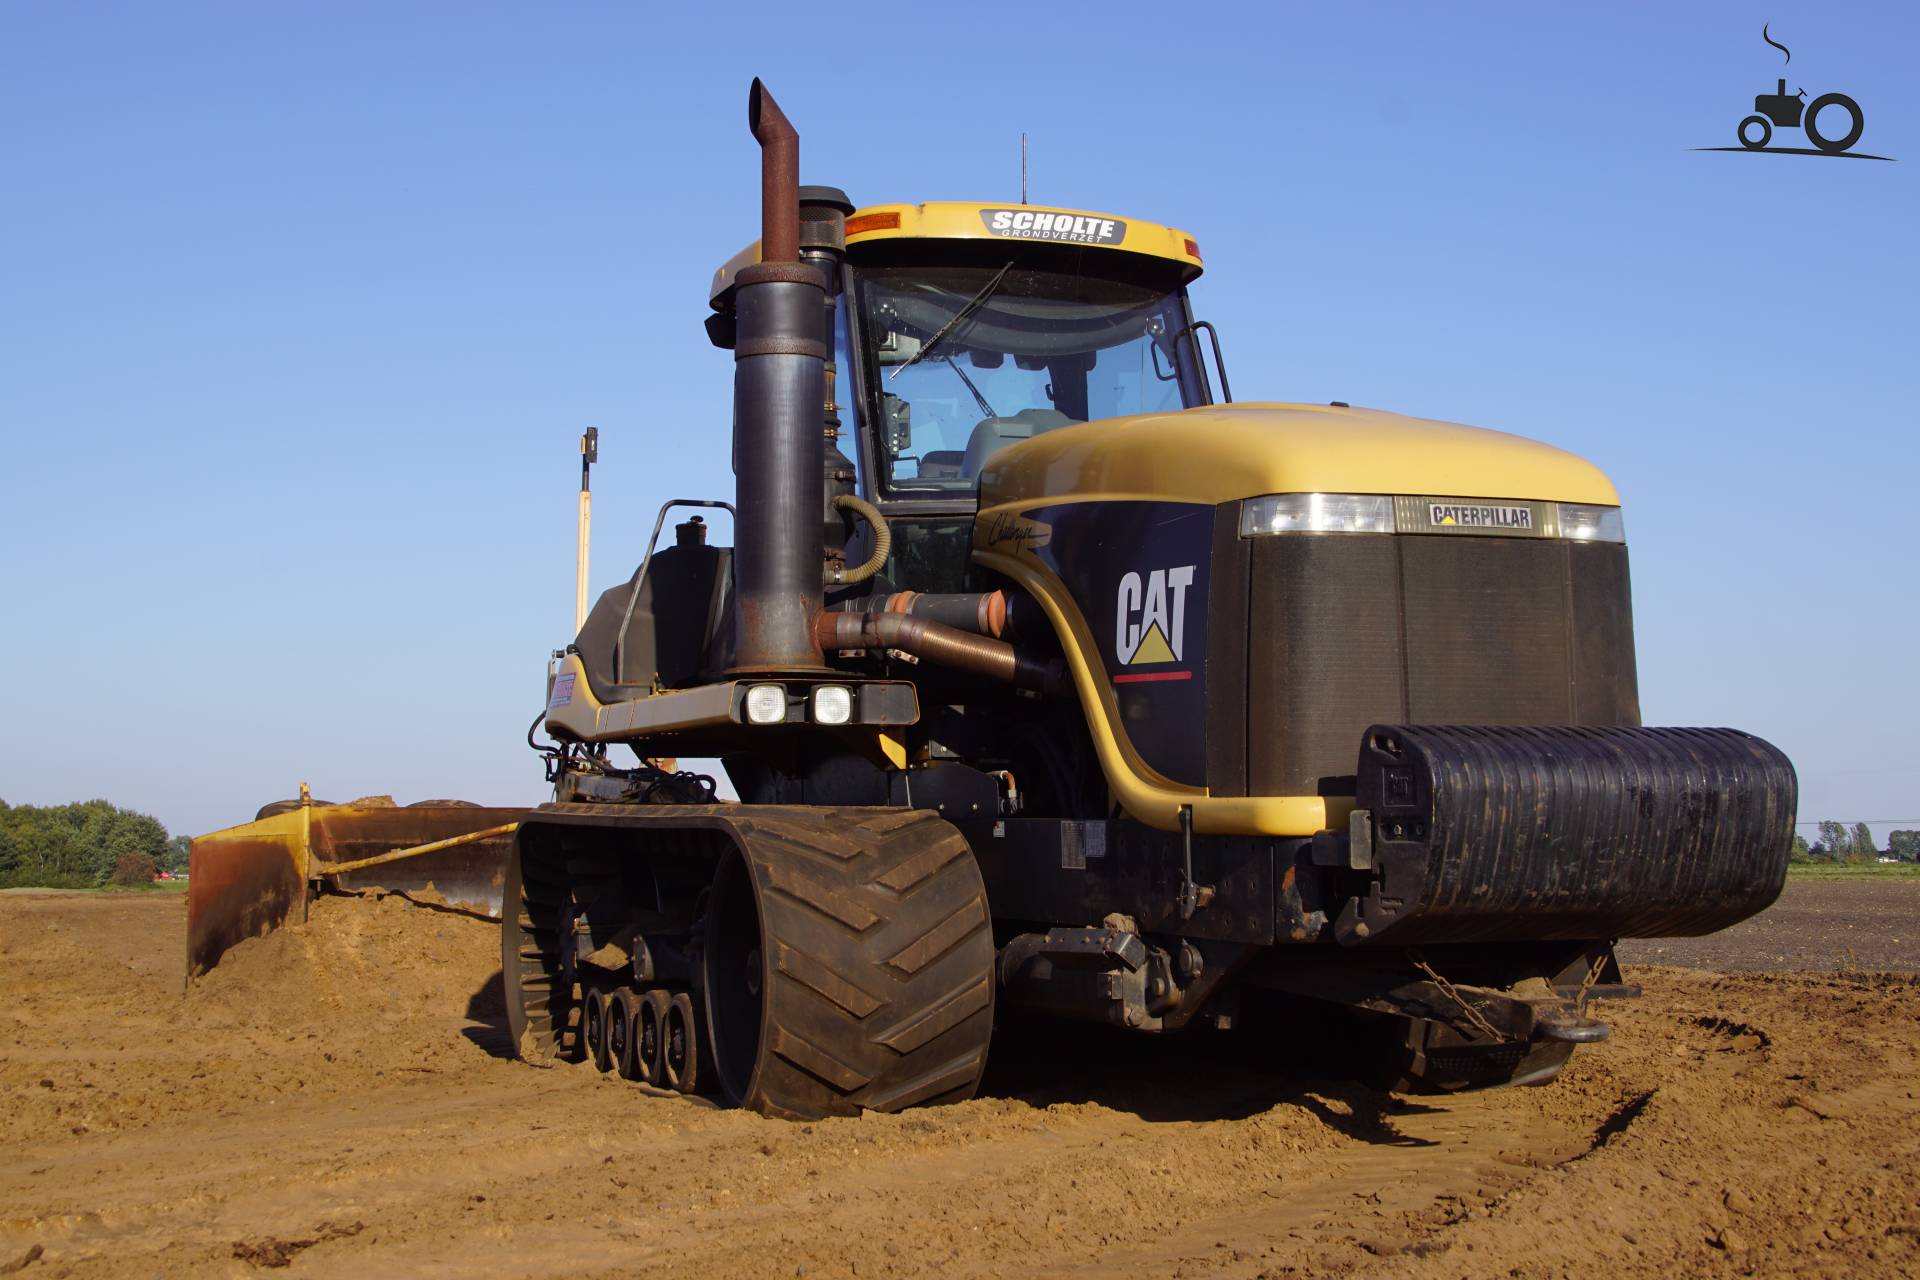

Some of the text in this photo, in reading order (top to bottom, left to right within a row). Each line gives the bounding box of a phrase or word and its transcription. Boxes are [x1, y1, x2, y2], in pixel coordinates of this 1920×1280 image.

[992, 211, 1115, 238] SCHOLTE
[1002, 229, 1103, 243] GRONDVERZET
[1432, 506, 1530, 527] CATERPILLAR
[1116, 565, 1194, 665] CAT
